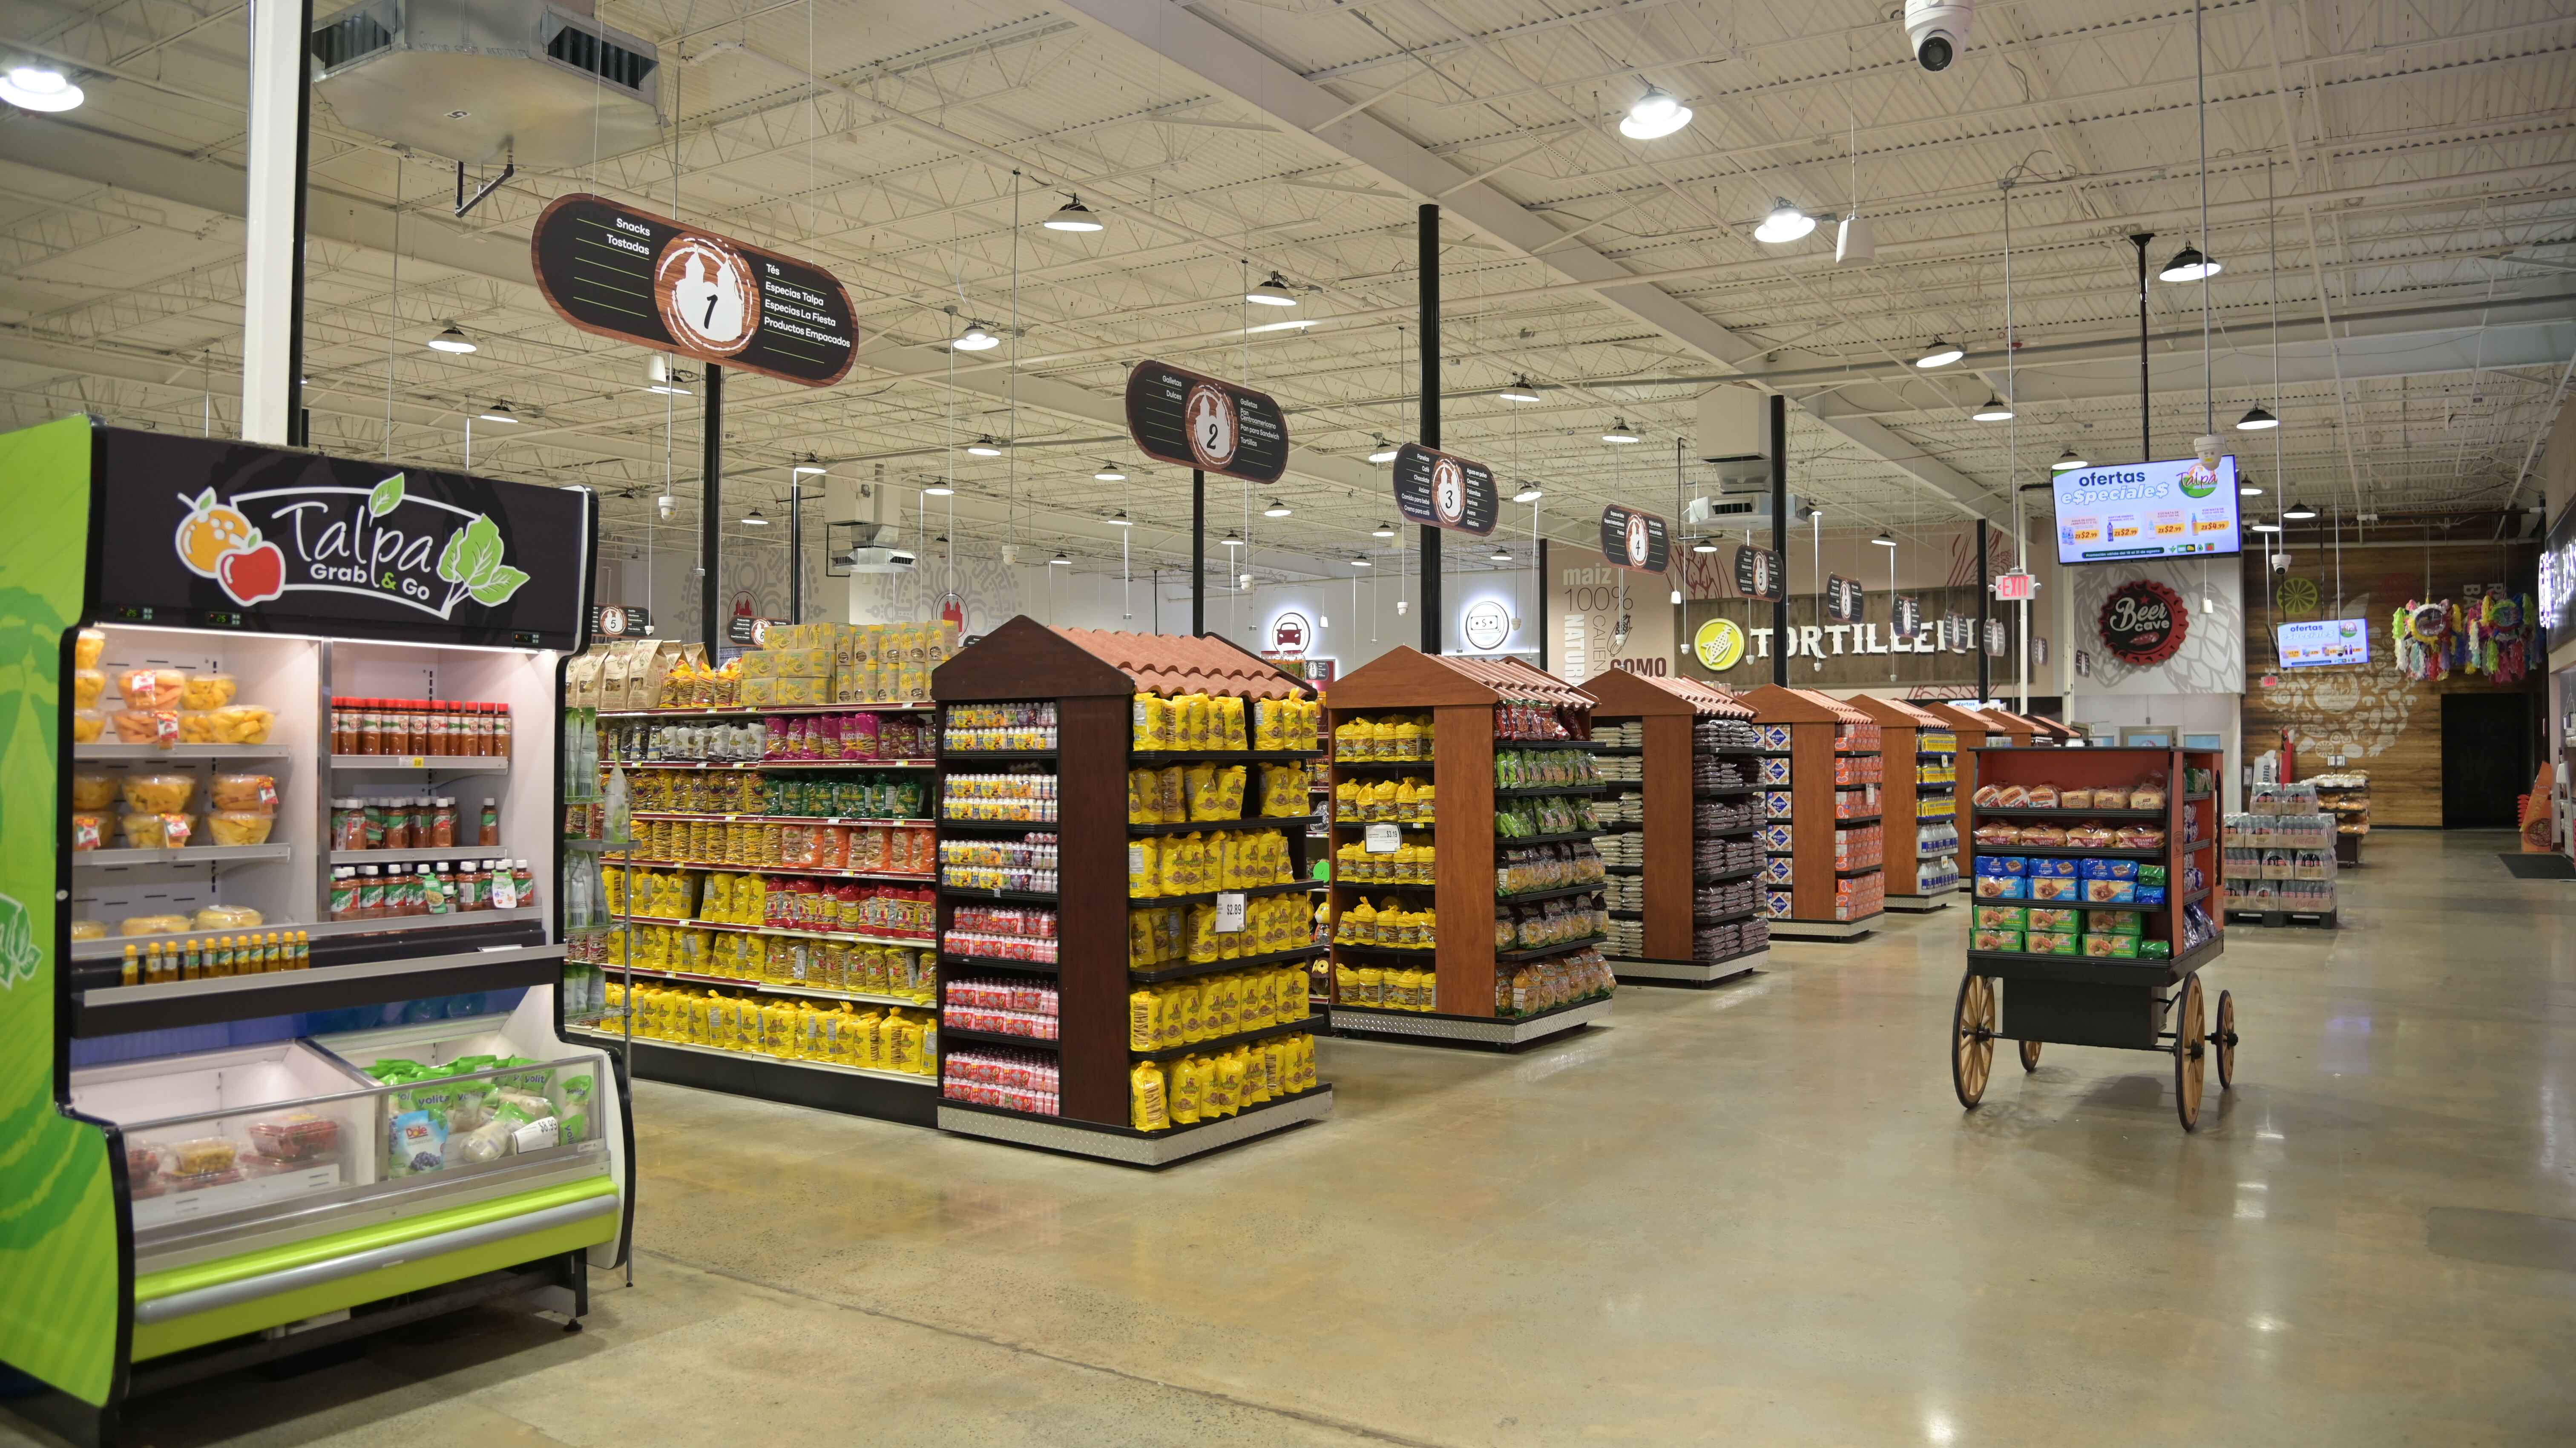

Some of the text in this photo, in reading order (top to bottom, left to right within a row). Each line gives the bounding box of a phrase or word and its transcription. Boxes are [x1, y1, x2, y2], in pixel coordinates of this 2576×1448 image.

[616, 218, 650, 236] Snacks
[607, 234, 650, 255] Tostadas
[766, 264, 780, 276] Tés
[765, 282, 824, 307] Especias Talpa
[704, 294, 719, 330] 1
[765, 299, 836, 327] Especias La Fiesta
[765, 317, 851, 348] Productos Empacados
[1162, 375, 1182, 387] Galletas
[1166, 390, 1182, 400] Dulces
[1240, 398, 1258, 409] Galletas
[1240, 415, 1276, 429] Centroamericano
[1207, 423, 1218, 450] 2
[1240, 437, 1257, 447] Tortillas
[1260, 429, 1279, 440] Sandwich
[1414, 474, 1430, 484] Chocolate
[2079, 471, 2146, 487] ofertas
[2176, 471, 2218, 489] Talpa
[1402, 493, 1414, 501] Comida
[1445, 490, 1452, 509] 3
[2061, 482, 2169, 506] e$peciale$
[272, 501, 434, 588] Talpa
[1636, 540, 1641, 556] 4
[310, 563, 431, 600] Grab & Go
[1563, 563, 1612, 586] maiz
[1759, 572, 1762, 586] 5
[2003, 577, 2029, 597] EXIT
[1564, 586, 1633, 612] 100%
[2110, 597, 2168, 632] Beer
[611, 620, 616, 629] 5
[2134, 619, 2170, 632] cave
[760, 631, 764, 639] 6
[1593, 615, 1606, 677] CALIEN
[1227, 904, 1241, 916] $2.89
[525, 1075, 546, 1083] yolit
[418, 1095, 451, 1106] yolita
[406, 1126, 428, 1139] Dole
[538, 1119, 558, 1133] $8.99
